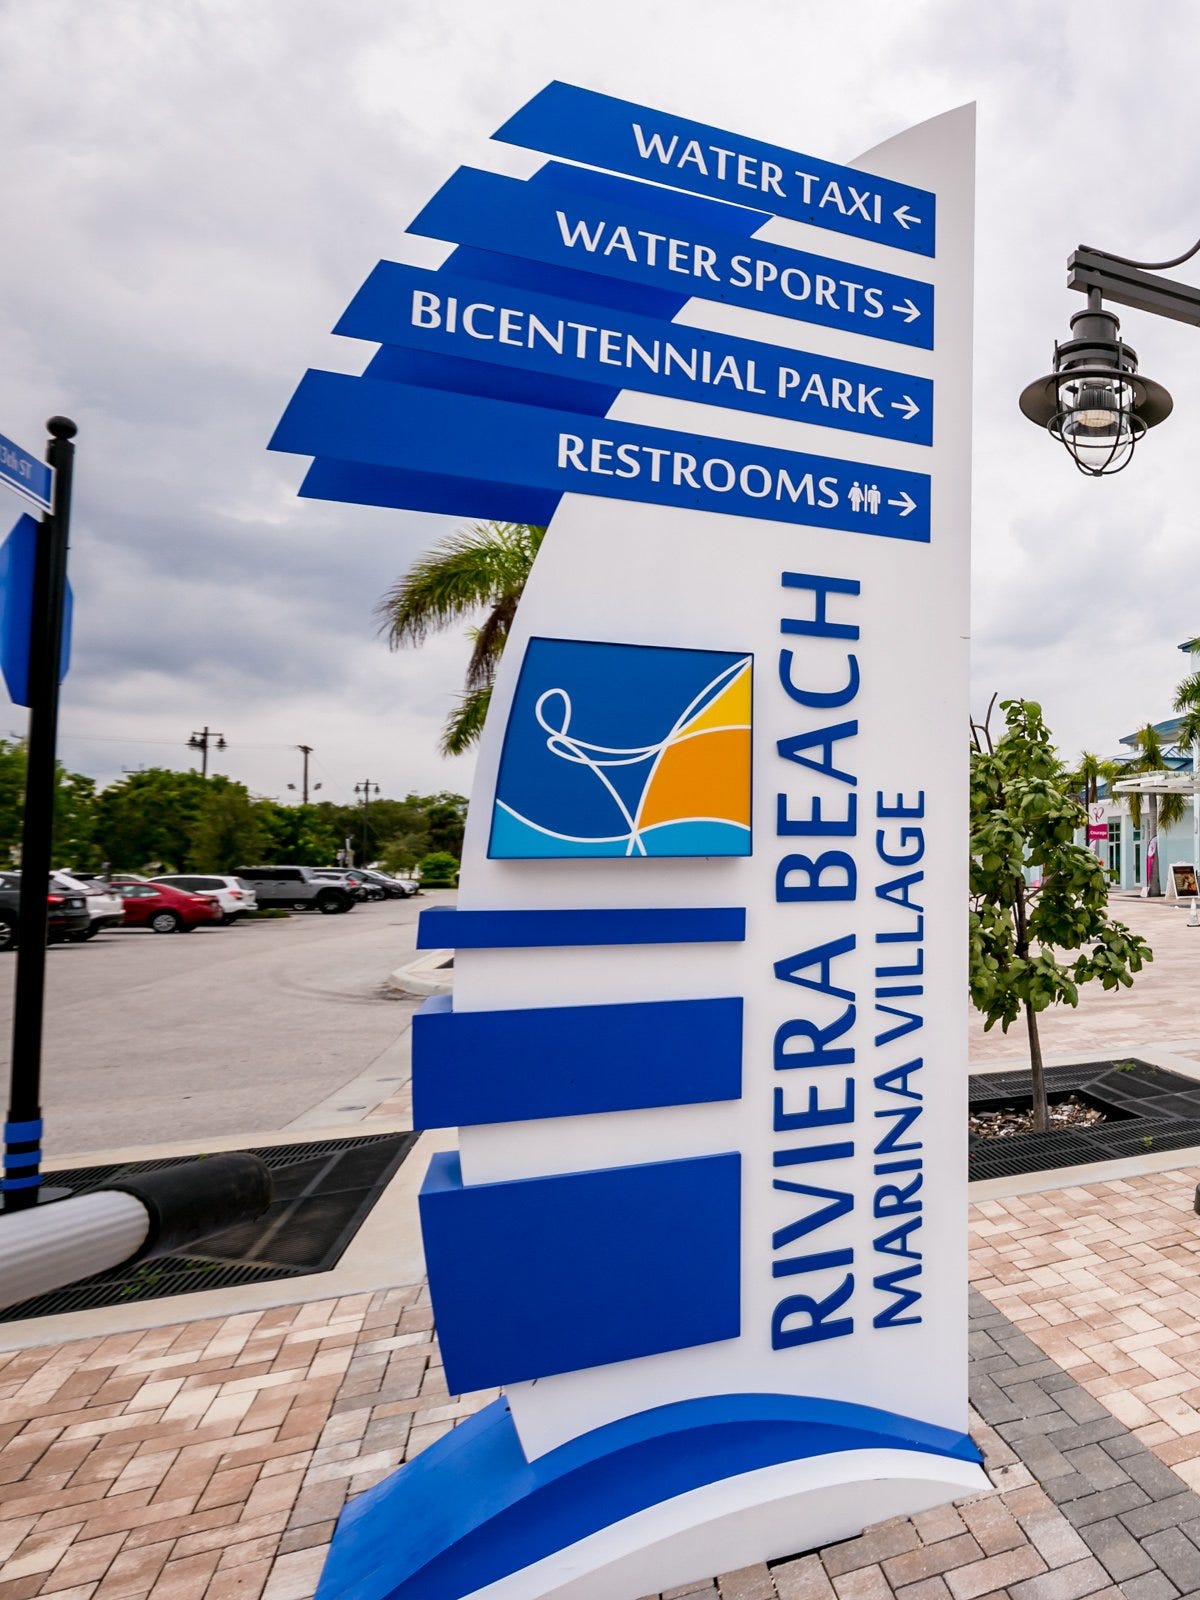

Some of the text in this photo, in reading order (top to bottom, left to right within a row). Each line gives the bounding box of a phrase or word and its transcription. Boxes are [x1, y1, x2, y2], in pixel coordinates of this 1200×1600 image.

[632, 123, 882, 224] WATER TAXI
[556, 210, 884, 318] WATER SPORTS
[411, 290, 884, 418] BICENTENNIAL PARK
[0, 444, 18, 472] 3th
[557, 433, 839, 509] RESTROOMS
[770, 570, 861, 1352] RIVIERA BEACH
[872, 790, 926, 1330] MARINA VILLAGE
